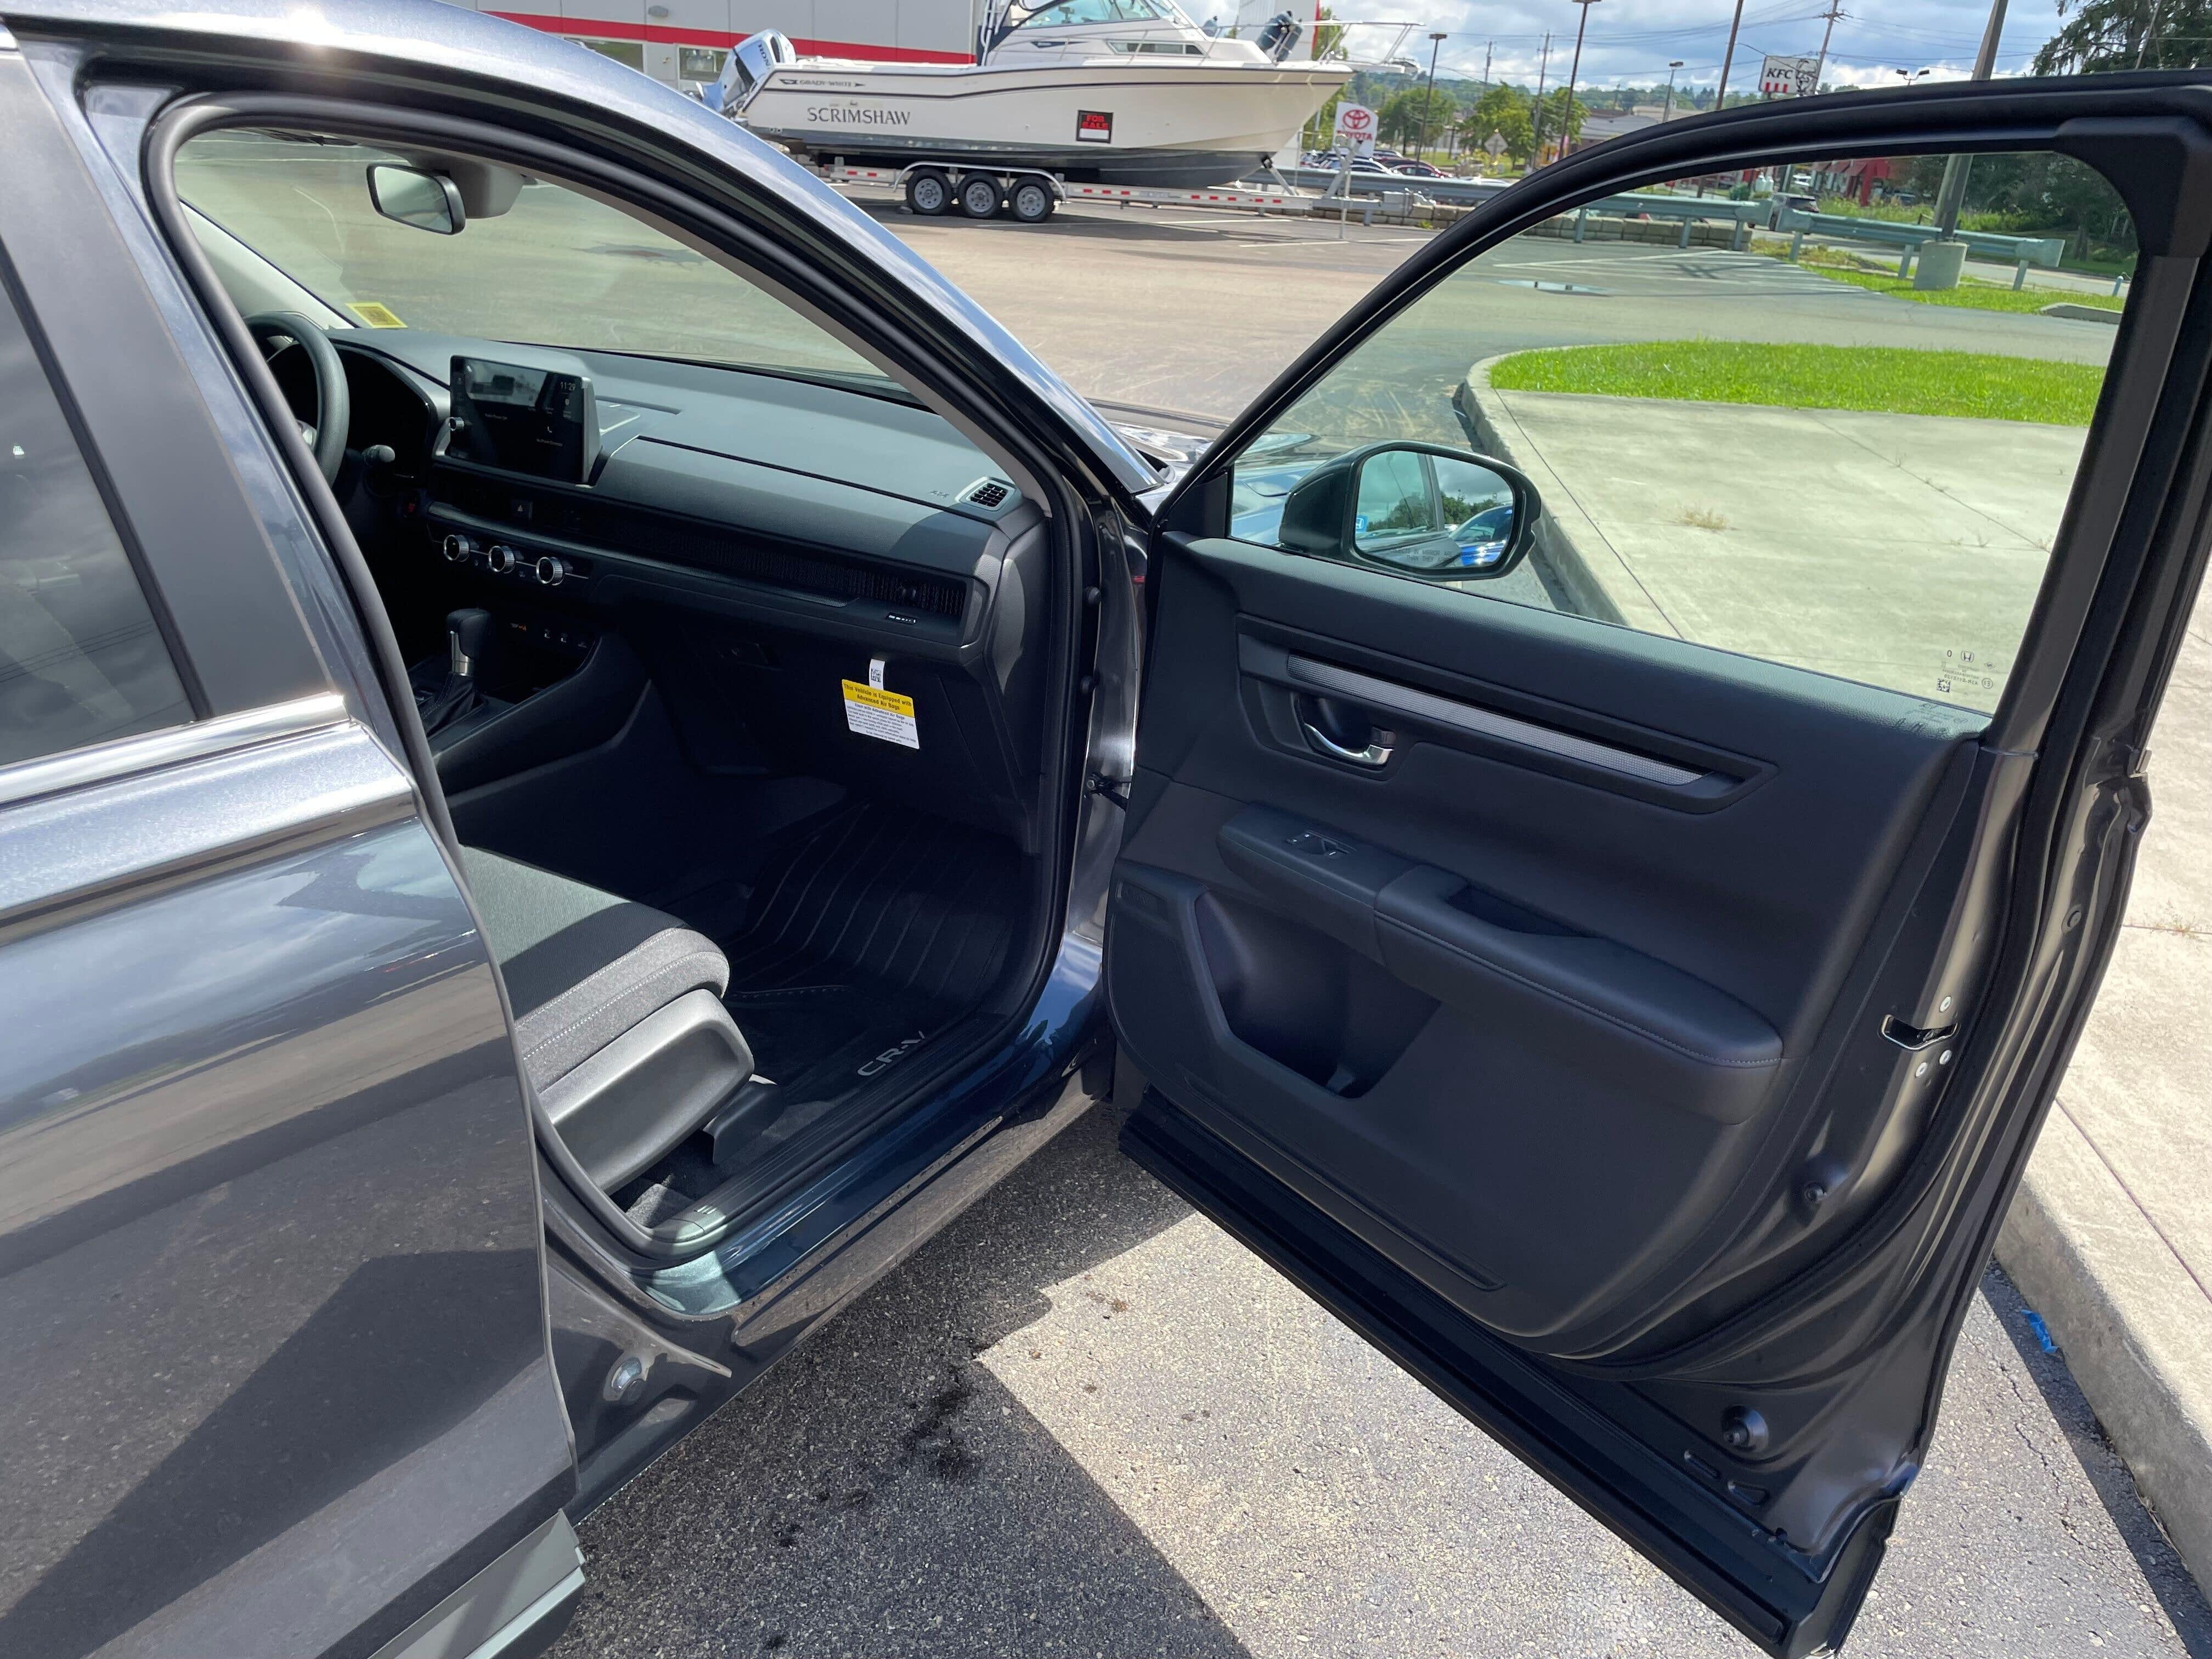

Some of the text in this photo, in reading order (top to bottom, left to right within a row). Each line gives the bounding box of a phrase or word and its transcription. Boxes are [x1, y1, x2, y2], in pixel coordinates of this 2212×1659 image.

[1766, 67, 1793, 79] KFC
[807, 107, 911, 125] SCRIMSHAW
[1082, 121, 1109, 129] SALE
[854, 686, 872, 696] Vehicle
[878, 693, 900, 704] Equipped
[857, 694, 879, 704] Advanced
[888, 702, 900, 710] Bags
[857, 1030, 926, 1076] CR-V
